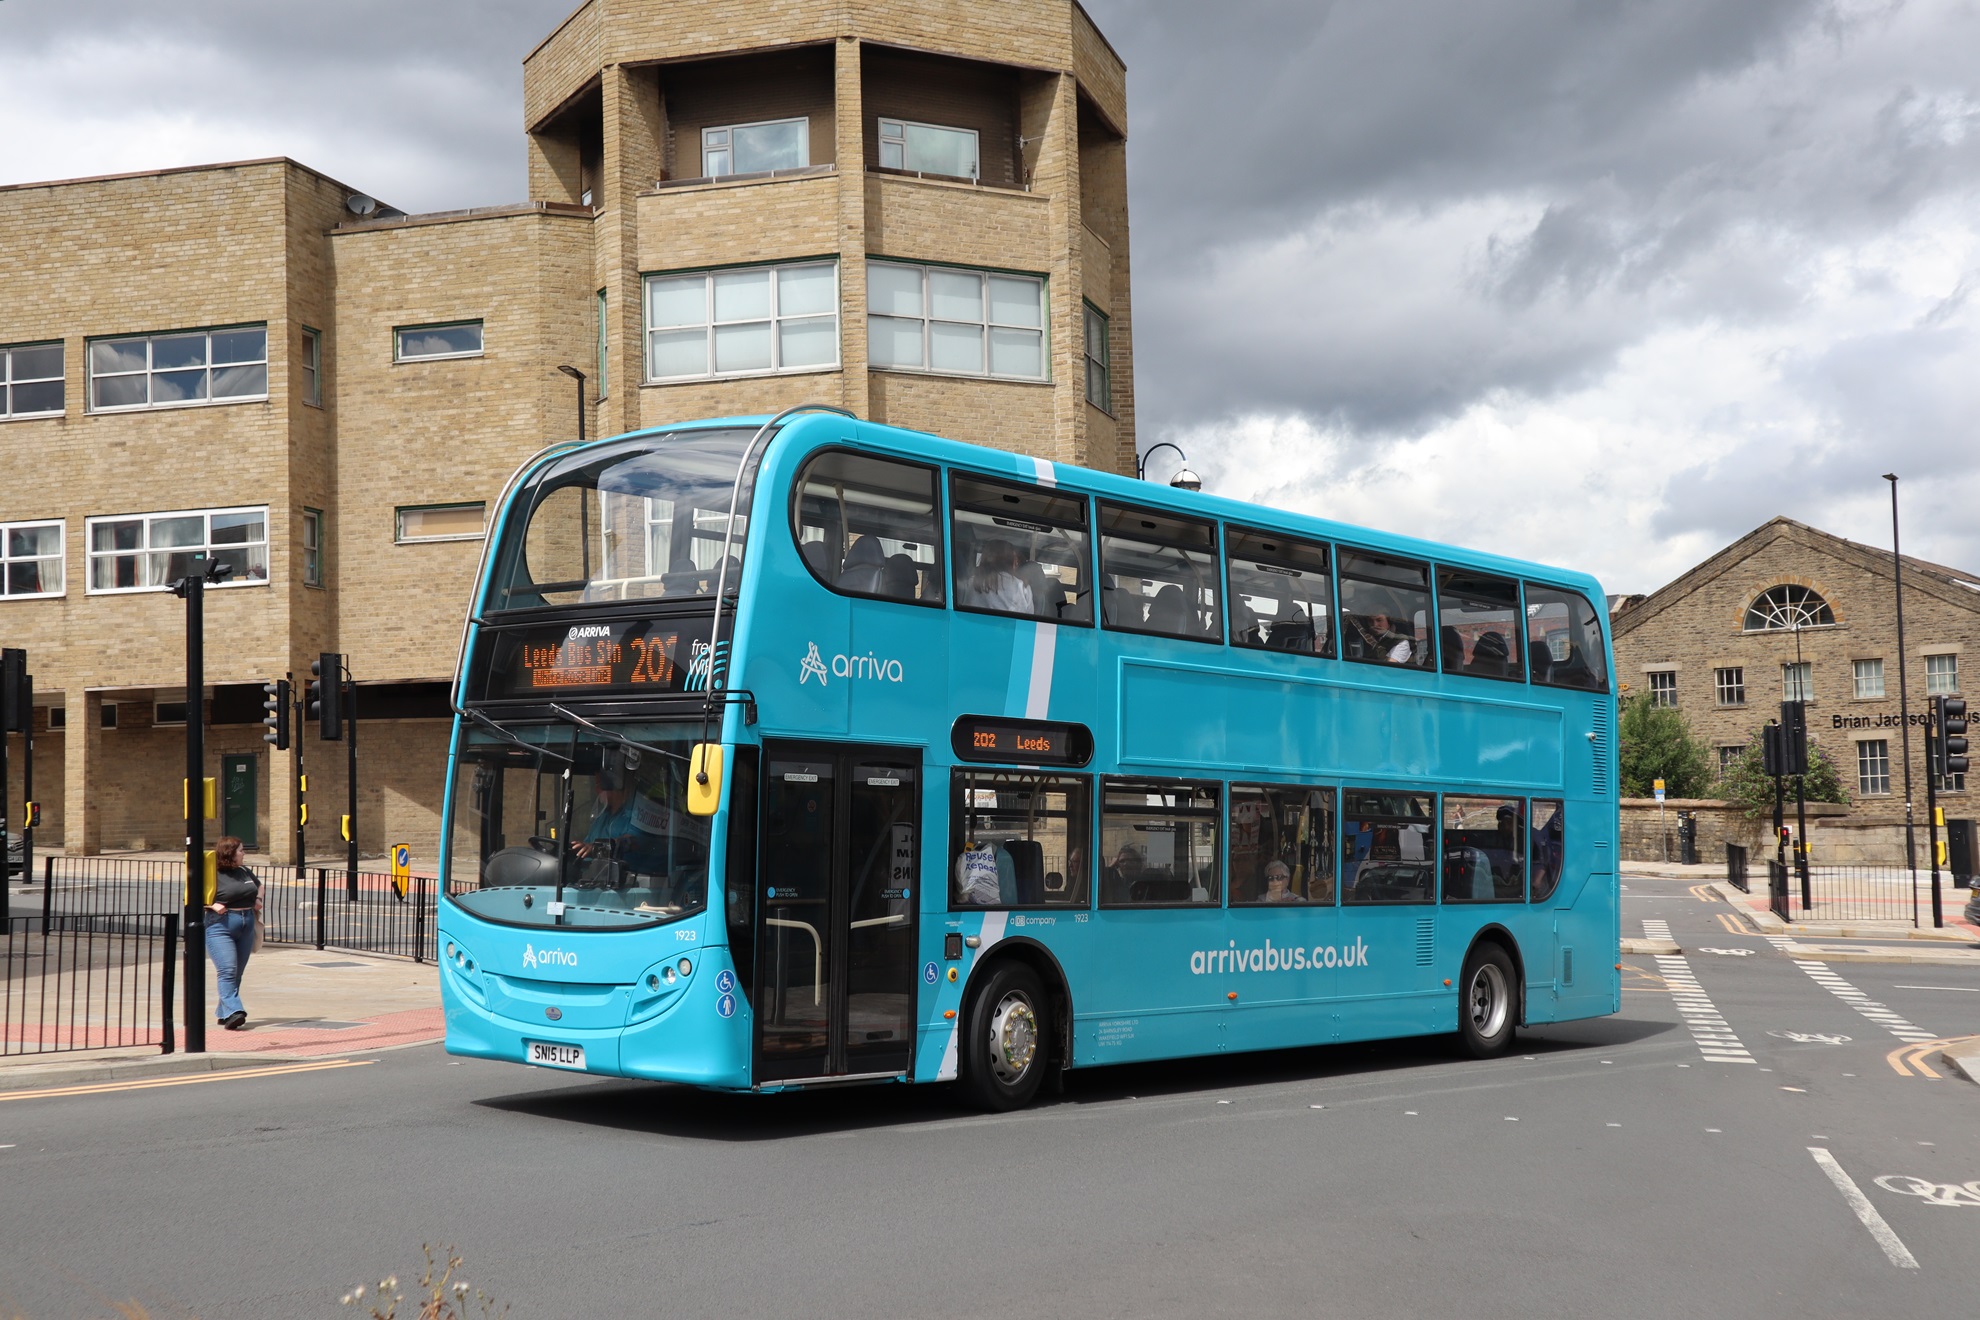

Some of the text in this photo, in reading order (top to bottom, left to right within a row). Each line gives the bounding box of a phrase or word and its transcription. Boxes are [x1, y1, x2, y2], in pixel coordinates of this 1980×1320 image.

[577, 626, 610, 638] ARRIVA
[524, 640, 622, 668] Leeds Bus Stn
[831, 651, 903, 682] arriva
[1832, 714, 1871, 728] Brian
[1875, 713, 1937, 727] Jacson
[973, 732, 1050, 751] 202 Leeds
[1026, 916, 1057, 926] company
[1074, 914, 1089, 923] 1923
[675, 930, 696, 941] 1923
[538, 948, 577, 966] arriva
[1190, 936, 1369, 975] arrivabus.co.uk
[534, 1045, 580, 1065] SN15 LLP
